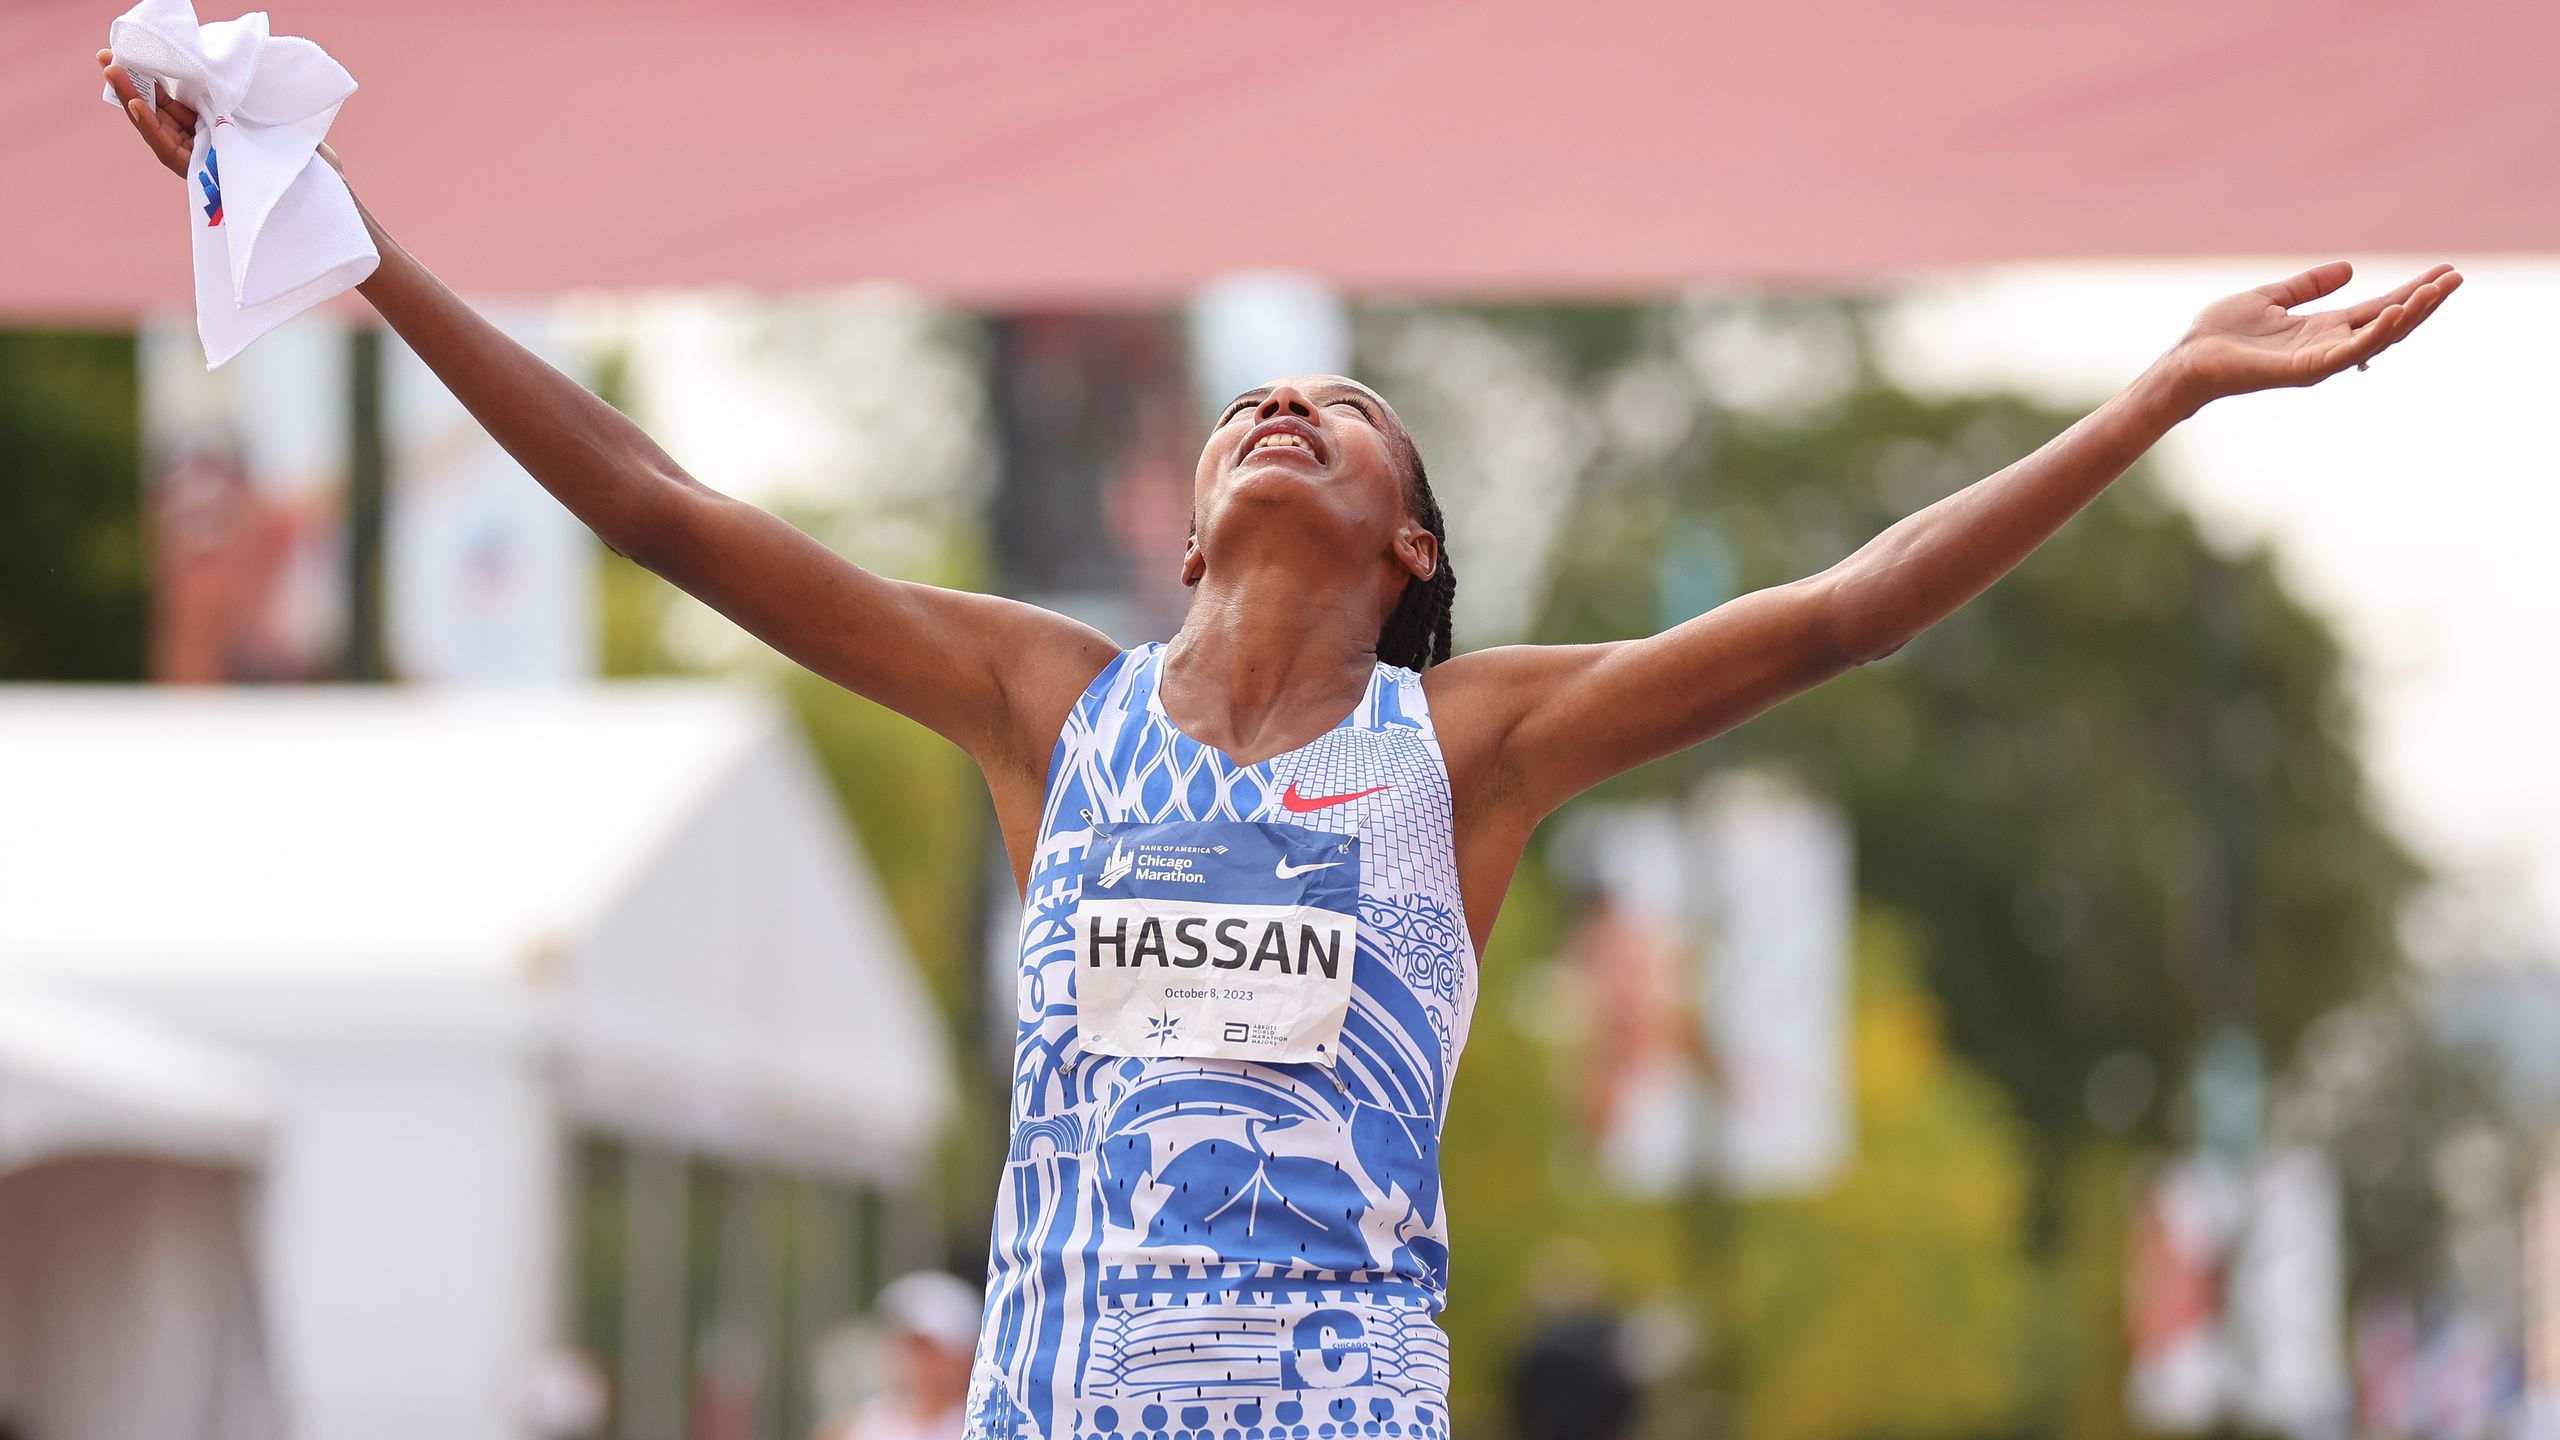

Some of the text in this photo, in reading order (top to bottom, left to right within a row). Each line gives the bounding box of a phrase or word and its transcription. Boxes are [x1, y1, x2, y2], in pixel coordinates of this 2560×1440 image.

[1175, 846, 1211, 854] AMERICA
[1138, 854, 1192, 870] Chicago
[1089, 916, 1341, 979] HASSAN
[1165, 988, 1254, 1001] October 8, 2023
